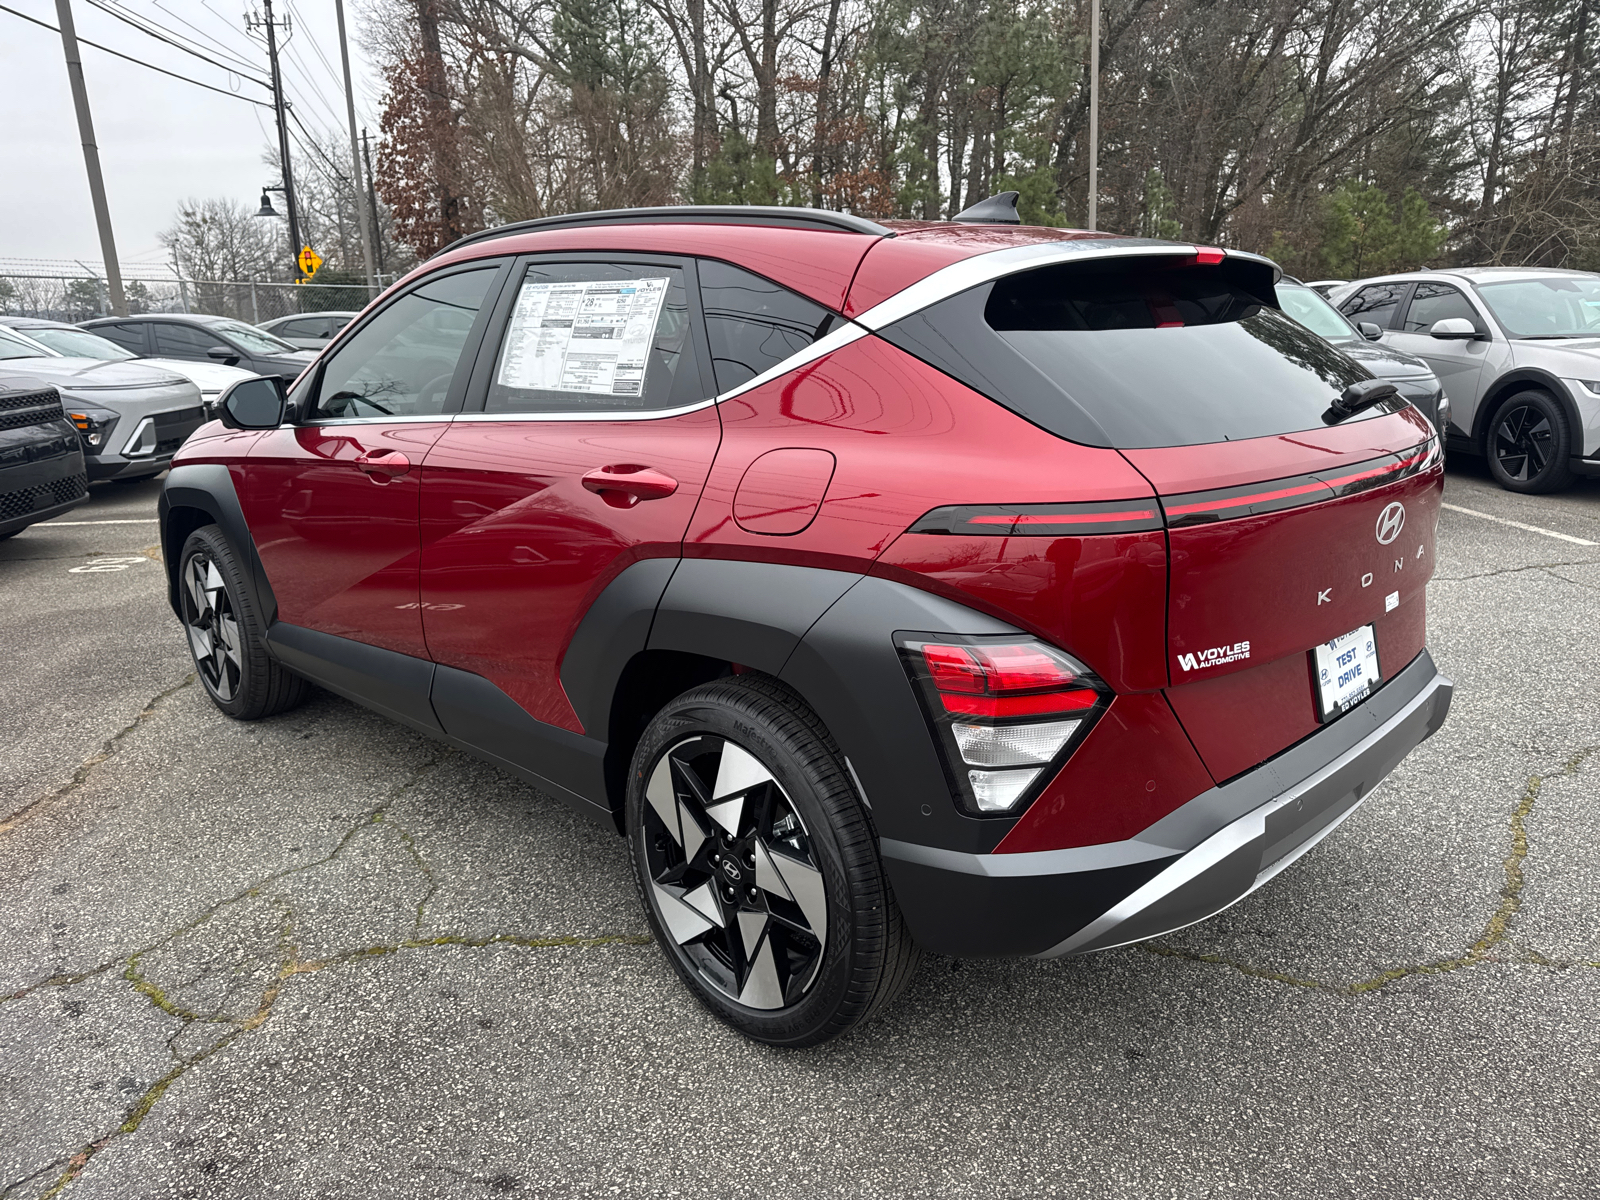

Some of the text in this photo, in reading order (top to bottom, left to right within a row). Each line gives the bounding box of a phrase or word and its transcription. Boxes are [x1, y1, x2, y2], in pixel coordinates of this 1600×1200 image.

[585, 297, 595, 307] 28
[1197, 640, 1251, 661] VOYLES
[1199, 651, 1251, 669] AUTOMOTIVE
[1336, 647, 1357, 669] TEST
[1337, 663, 1363, 689] DRIVE
[1350, 687, 1371, 706] VOYLES
